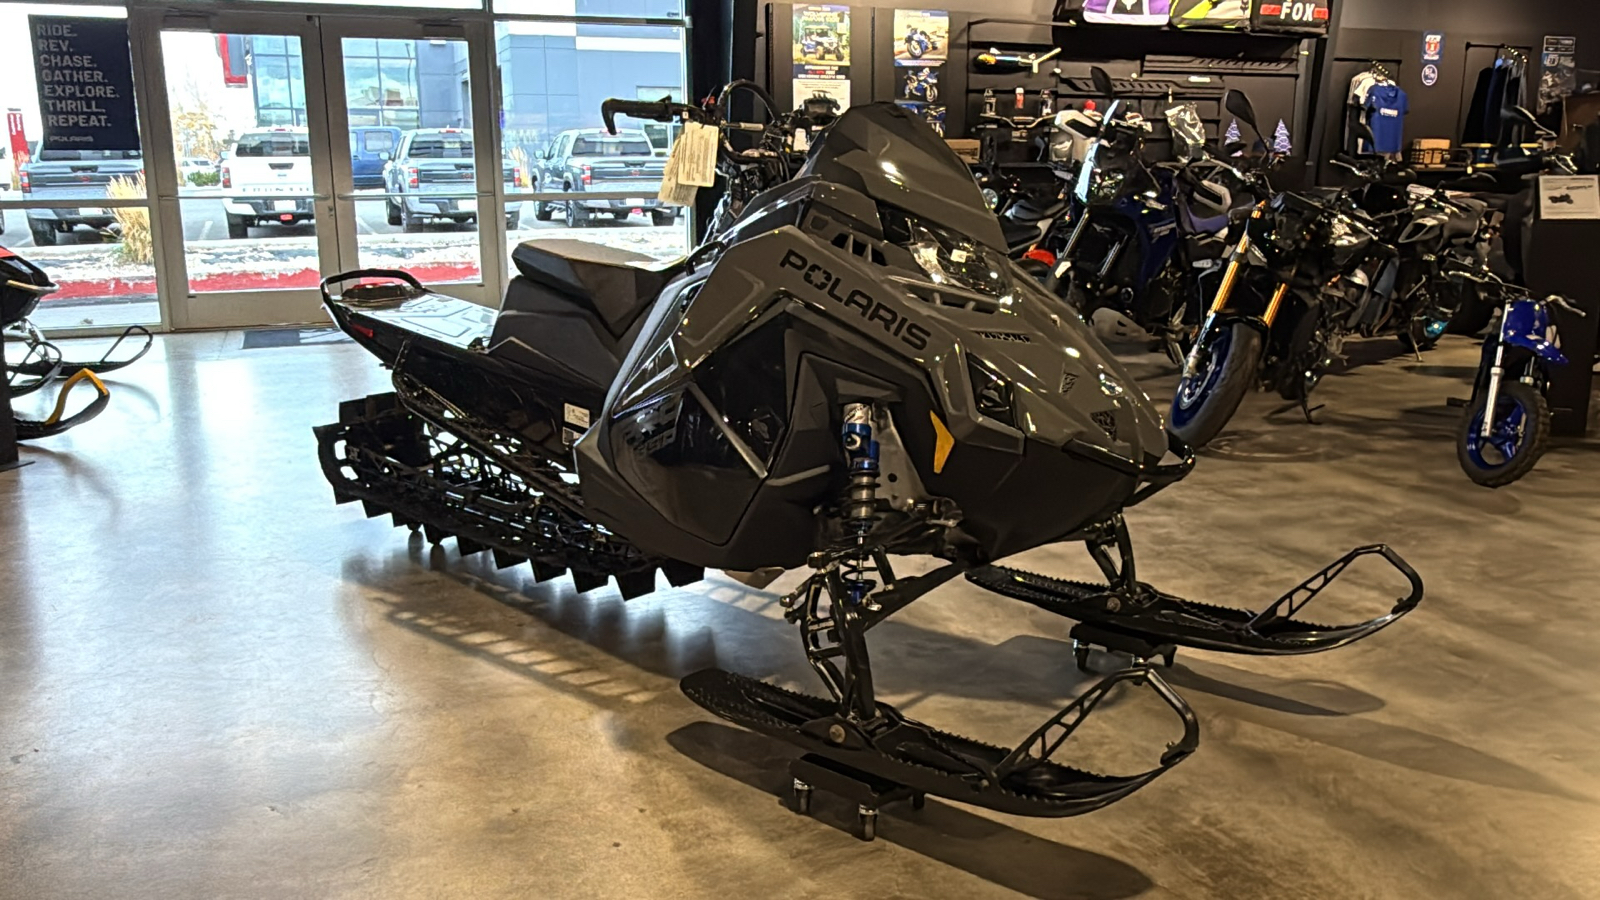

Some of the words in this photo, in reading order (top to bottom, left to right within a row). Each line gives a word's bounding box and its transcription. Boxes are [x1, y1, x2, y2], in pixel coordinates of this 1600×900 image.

[1280, 2, 1315, 21] FOX
[36, 24, 78, 37] RIDE.
[38, 39, 73, 52] REV.
[40, 54, 97, 67] CHASE.
[42, 69, 108, 82] GATHER.
[44, 84, 120, 98] EXPLORE.
[45, 99, 106, 113] THRILL.
[48, 114, 112, 127] REPEAT.
[779, 248, 932, 350] POLARIS
